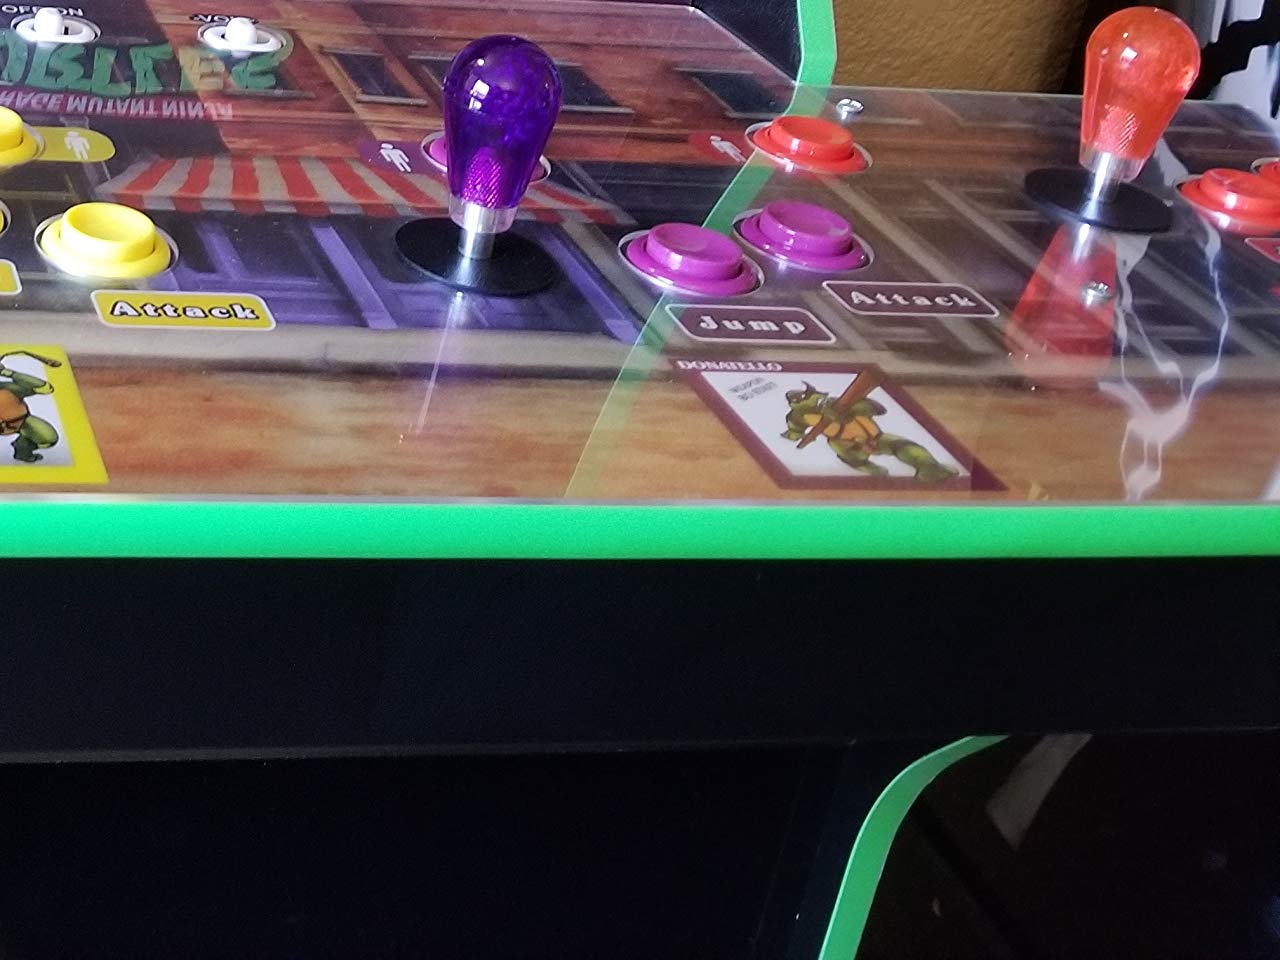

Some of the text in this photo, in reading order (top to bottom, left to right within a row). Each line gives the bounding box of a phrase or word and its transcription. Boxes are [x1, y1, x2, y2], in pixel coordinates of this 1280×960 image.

[110, 299, 262, 321] Attack
[849, 289, 978, 309] Attack
[697, 314, 807, 337] Jump
